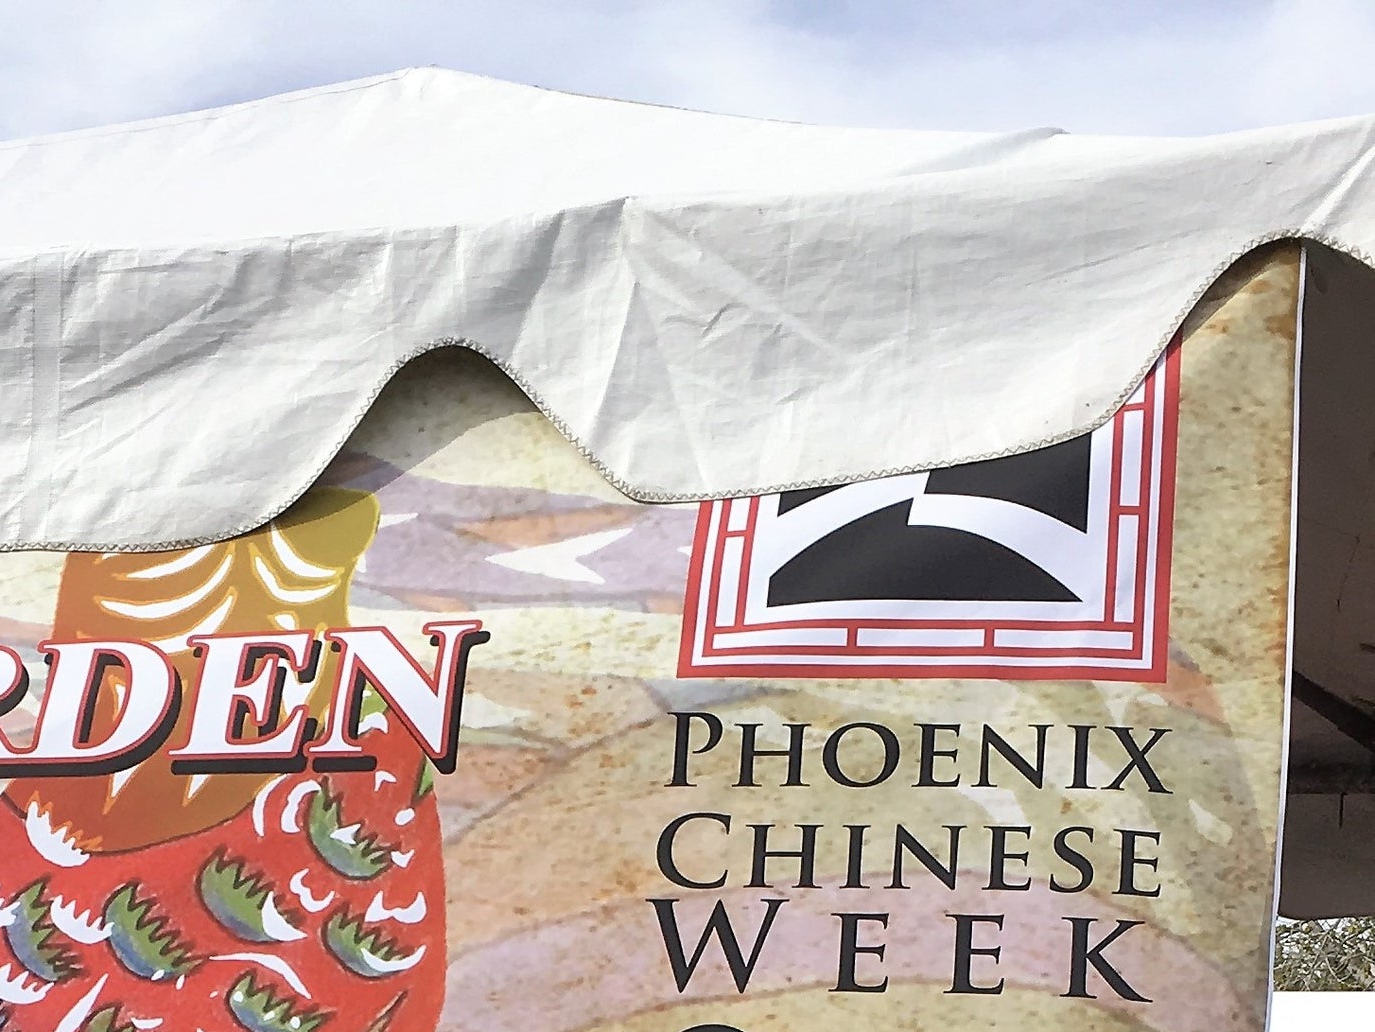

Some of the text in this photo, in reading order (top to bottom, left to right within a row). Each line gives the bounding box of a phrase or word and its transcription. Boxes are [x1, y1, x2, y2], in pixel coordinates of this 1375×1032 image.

[664, 711, 1173, 794] PHOENIX
[656, 812, 1162, 898] CHINESE
[646, 898, 1153, 1003] WEEK
